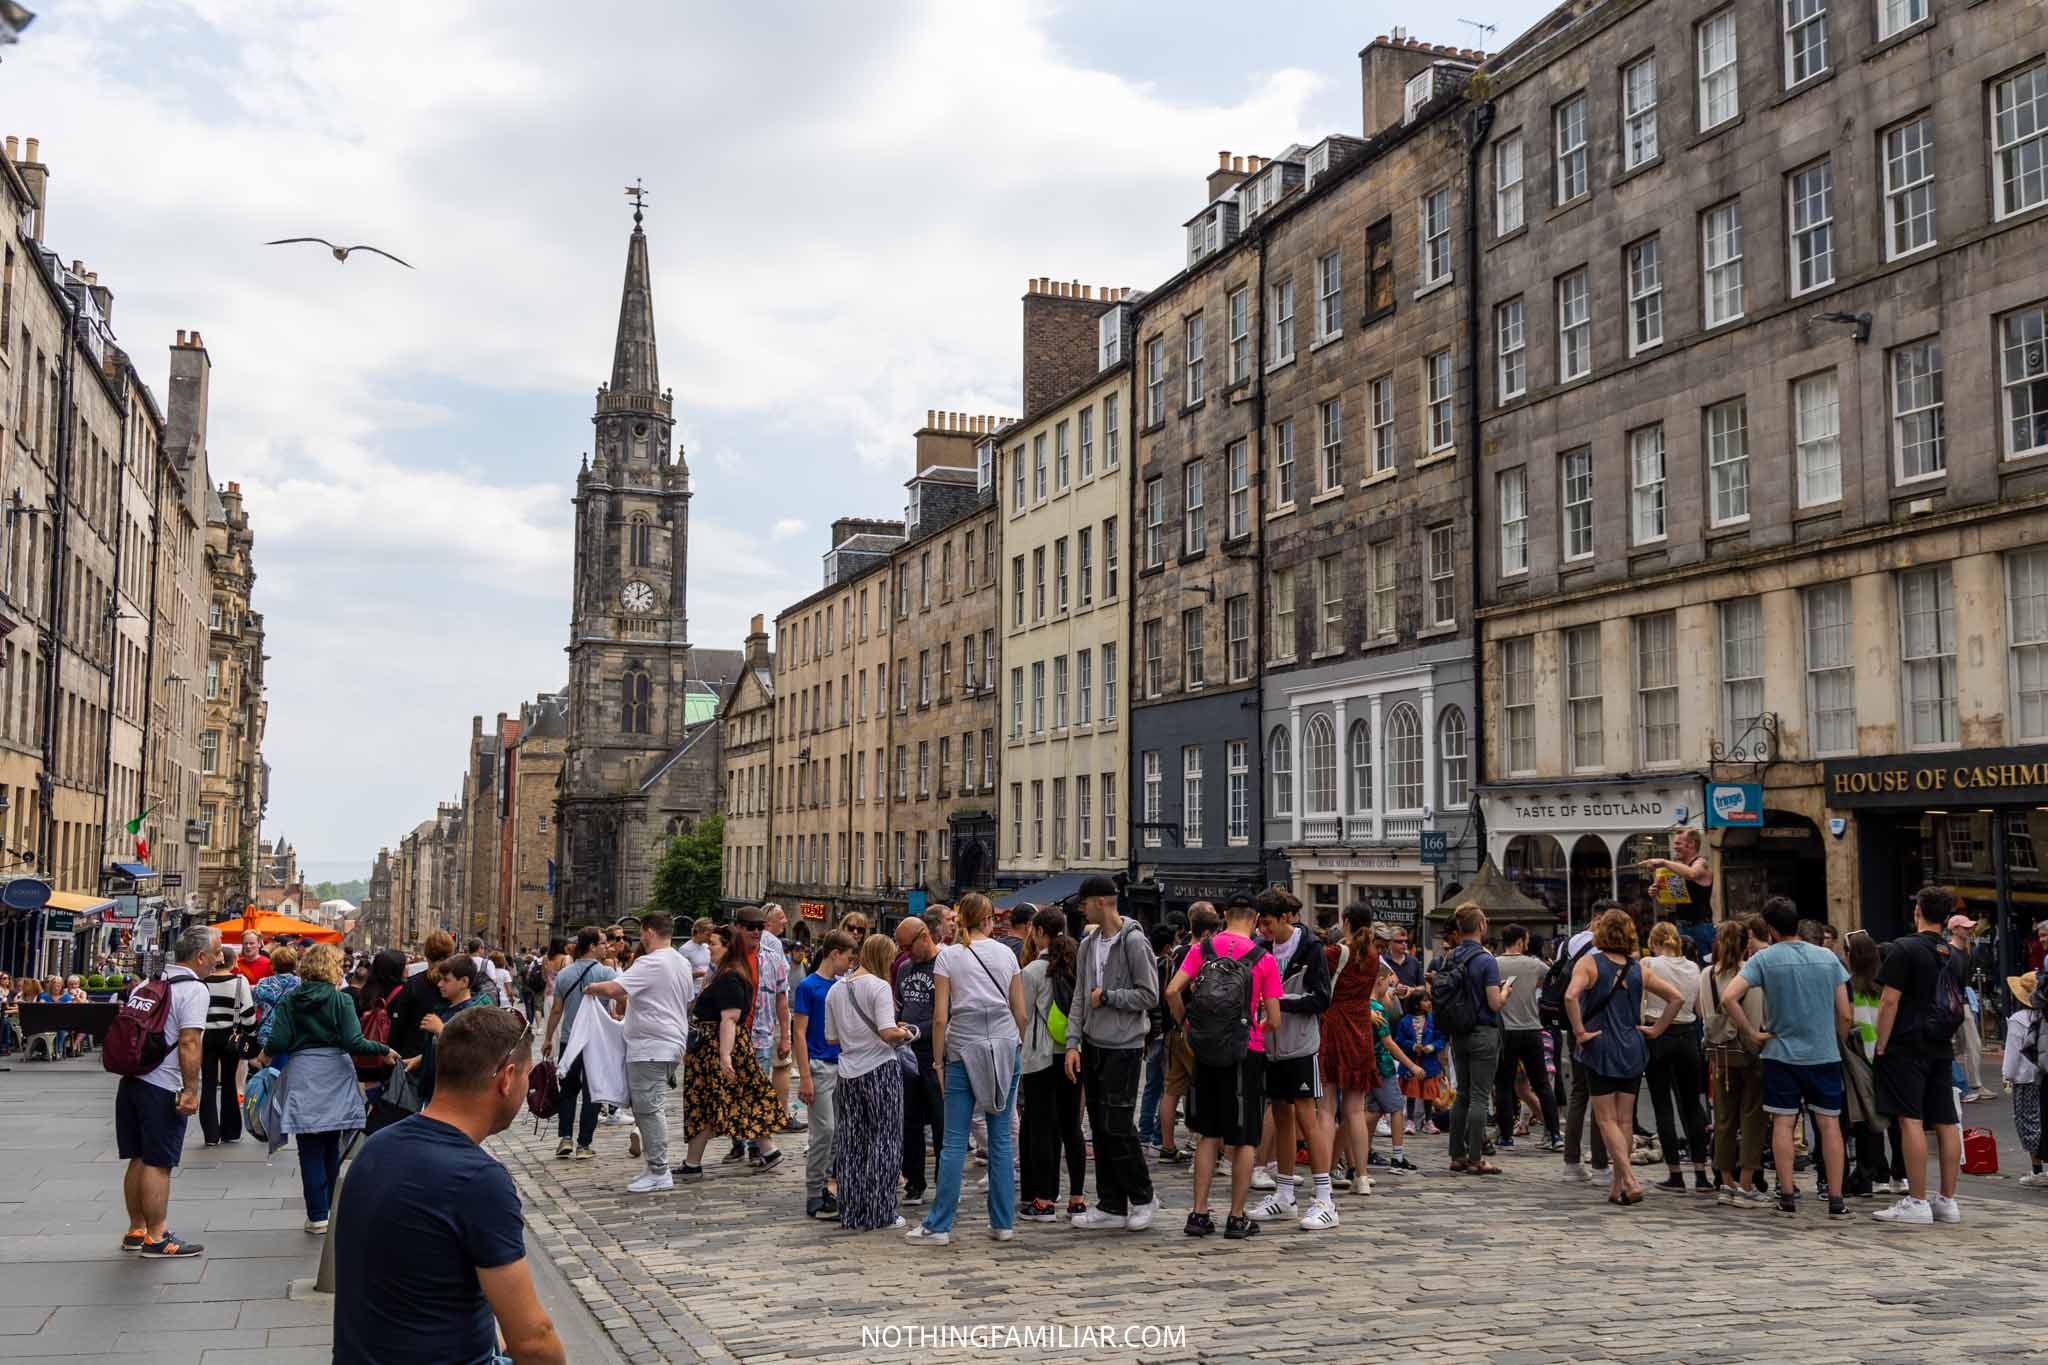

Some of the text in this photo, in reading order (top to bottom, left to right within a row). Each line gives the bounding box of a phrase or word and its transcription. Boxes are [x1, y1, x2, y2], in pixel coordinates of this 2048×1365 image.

[1834, 771, 1909, 793] HOUSE
[1916, 768, 1947, 790] OF
[1516, 806, 1554, 818] TASTE
[1561, 805, 1578, 817] OF
[1583, 802, 1662, 816] SCOTLAND
[1424, 837, 1444, 849] 166
[1379, 911, 1415, 921] CASHMERE
